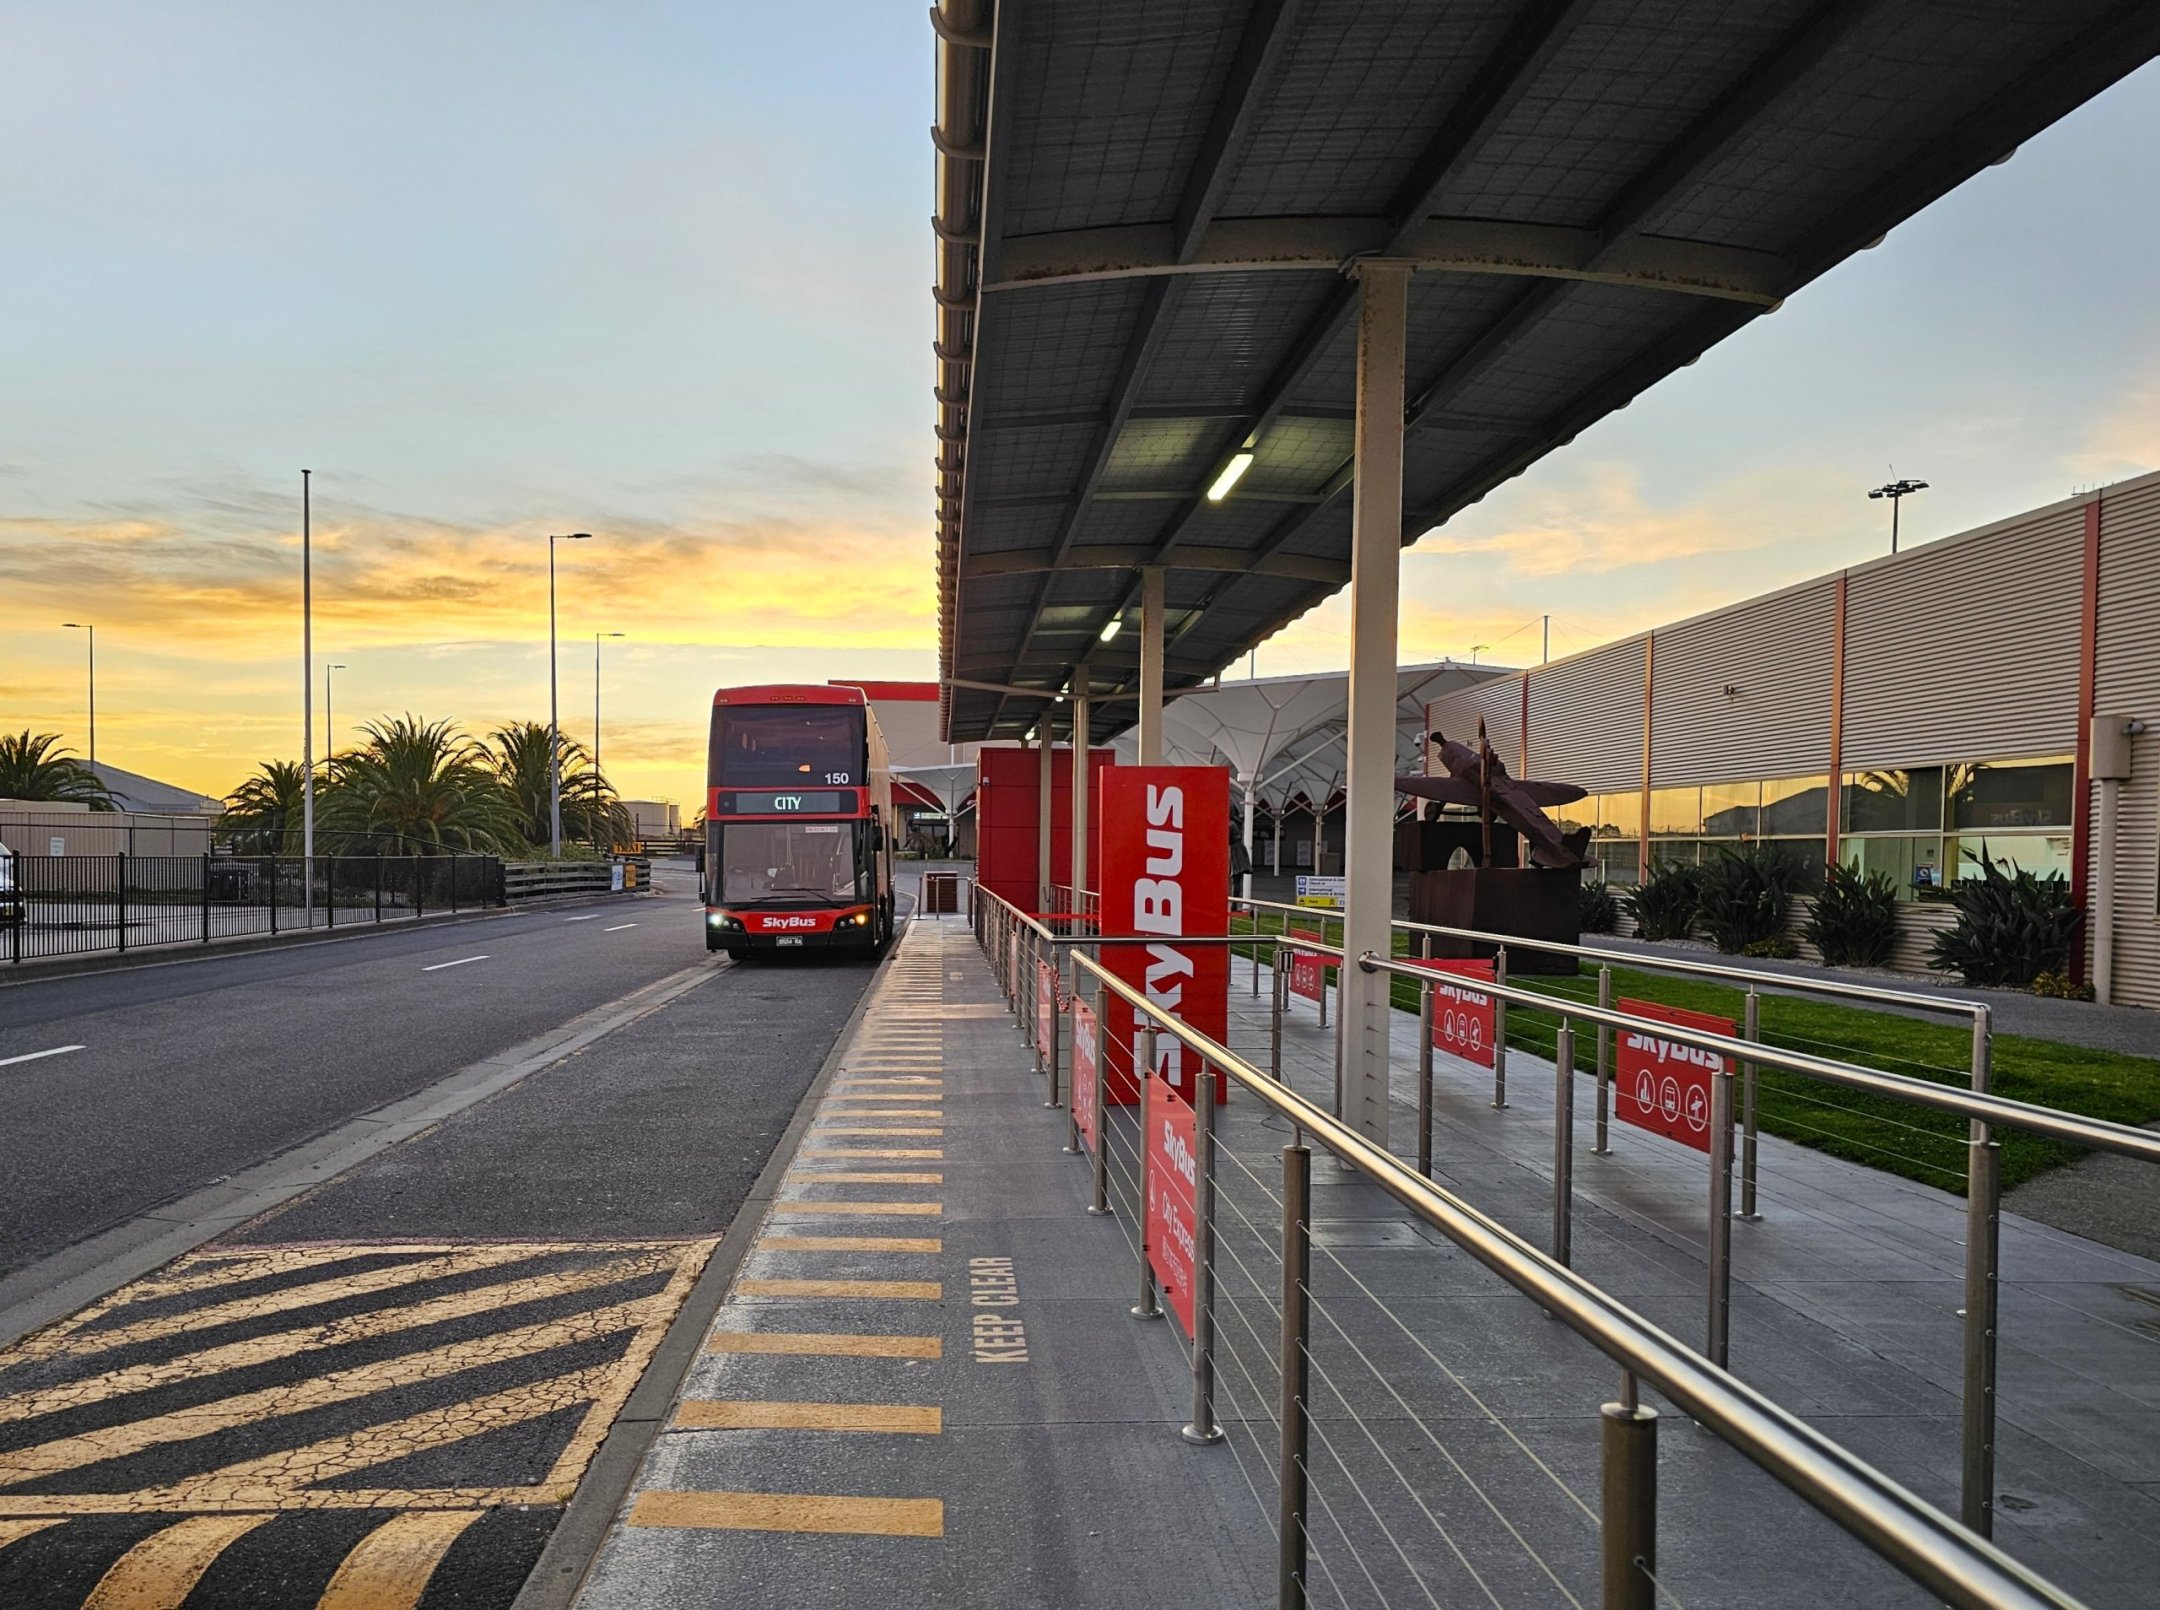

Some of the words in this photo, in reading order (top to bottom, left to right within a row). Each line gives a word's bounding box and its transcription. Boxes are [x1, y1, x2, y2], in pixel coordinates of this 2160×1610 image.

[825, 773, 849, 784] 150
[774, 797, 801, 810] CITY
[762, 917, 817, 929] SkyBus
[1133, 784, 1193, 1086] SkyBus
[1163, 1119, 1195, 1187] SkyBus
[1163, 1190, 1173, 1234] City
[1173, 1205, 1195, 1263] Express
[969, 1257, 1020, 1306] CLEAR
[973, 1314, 1029, 1362] KEEP
